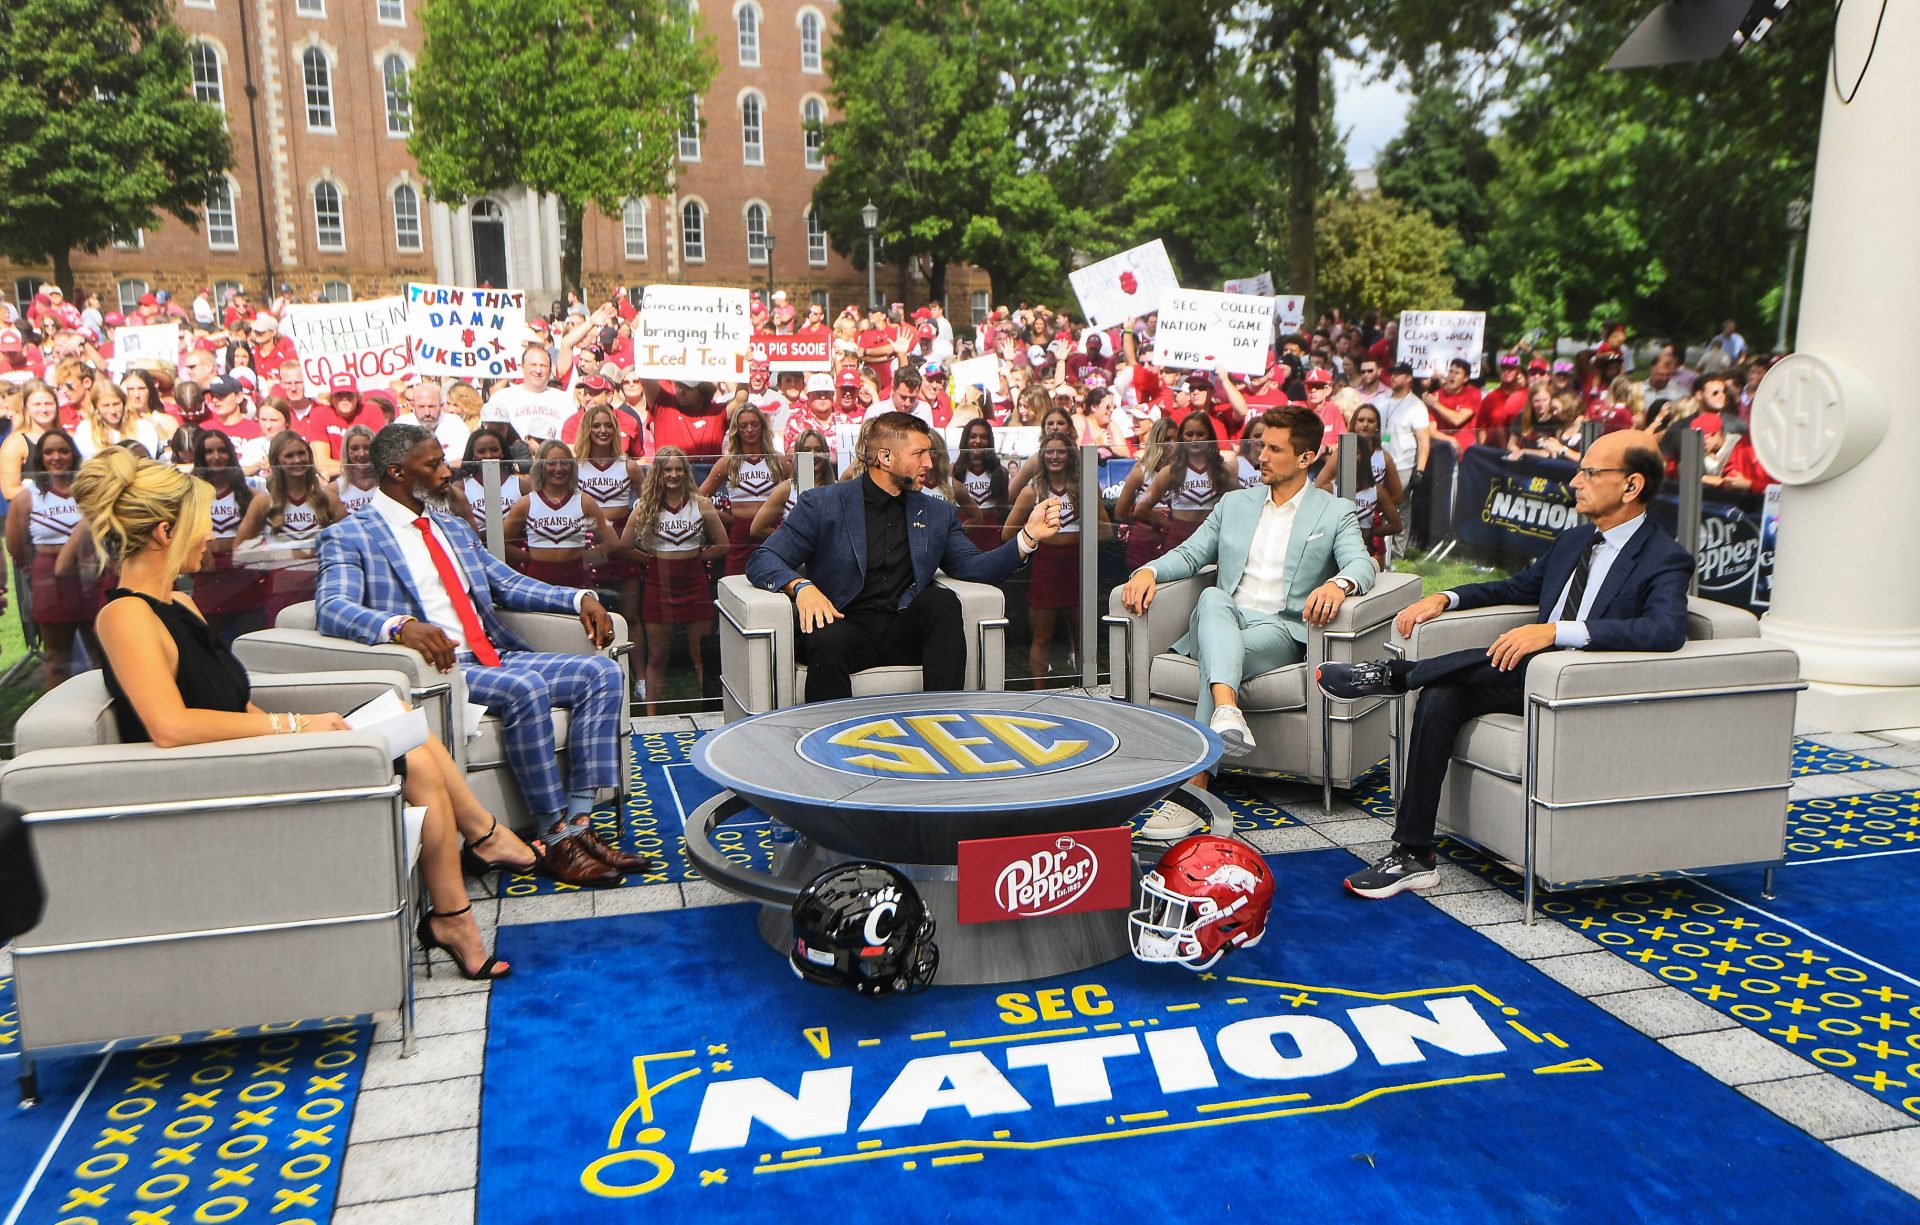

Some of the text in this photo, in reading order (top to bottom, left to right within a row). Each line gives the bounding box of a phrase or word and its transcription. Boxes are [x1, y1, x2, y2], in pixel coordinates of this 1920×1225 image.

[411, 286, 523, 309] TURN THAT
[643, 294, 743, 316] Cincinnati's
[1173, 300, 1198, 311] SEC
[365, 310, 385, 331] IS
[389, 301, 406, 326] IN
[1220, 301, 1272, 316] COLLEGE
[429, 310, 504, 330] DAMN
[1160, 320, 1207, 332] NATION
[1228, 319, 1263, 331] GAME
[1404, 313, 1435, 326] BEN
[643, 320, 740, 345] bringing the
[1233, 336, 1260, 348] DAY
[642, 344, 727, 366] Iced Tea
[768, 341, 788, 356] PIG
[790, 341, 826, 356] SOOIE
[1174, 351, 1200, 363] WPS
[1408, 344, 1429, 355] THE
[304, 357, 333, 386] GO
[582, 476, 624, 490] ARKANSAS
[1528, 476, 1548, 493] SEC
[532, 516, 580, 530] ARKANSAS
[1706, 516, 1737, 550] Dr
[826, 713, 1090, 775] SEC
[1031, 850, 1068, 883] Dr
[995, 859, 1091, 913] Pepper
[864, 900, 899, 947] C
[995, 983, 1115, 1025] SEC
[688, 996, 1508, 1153] NATION
